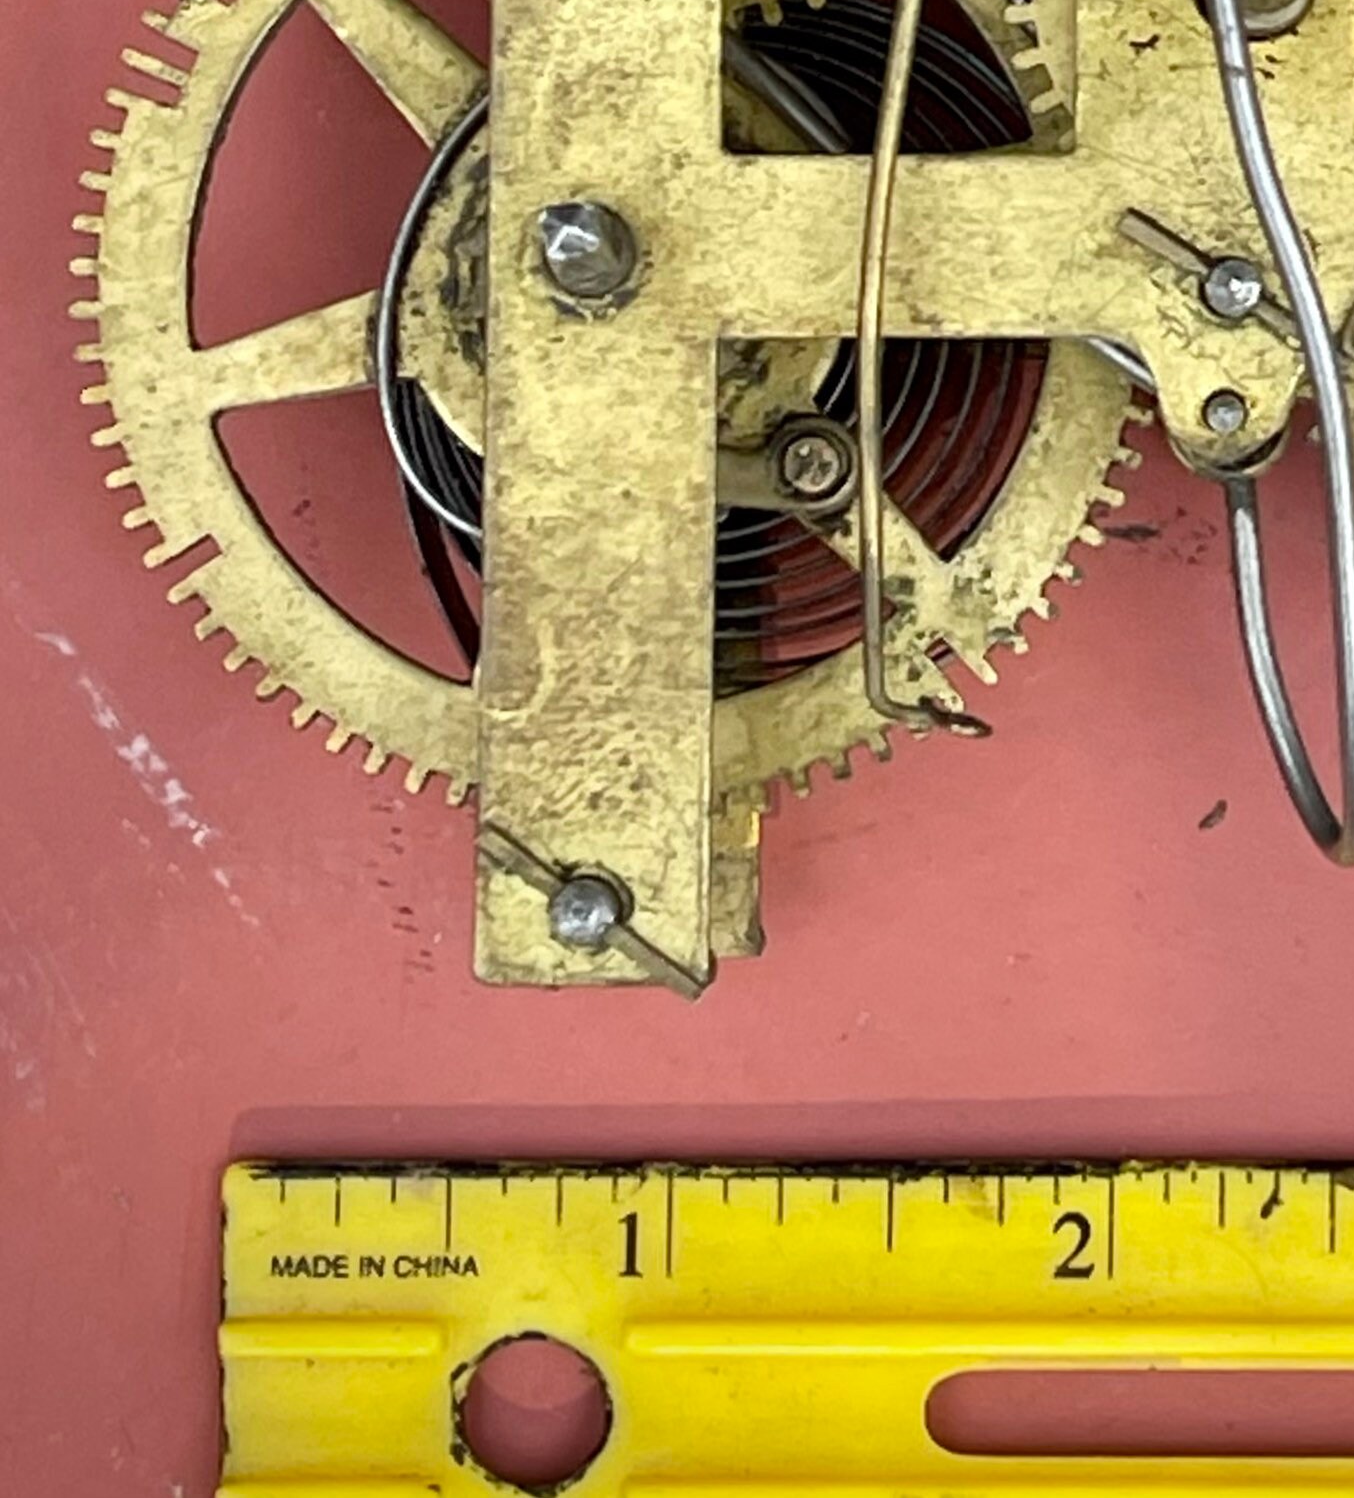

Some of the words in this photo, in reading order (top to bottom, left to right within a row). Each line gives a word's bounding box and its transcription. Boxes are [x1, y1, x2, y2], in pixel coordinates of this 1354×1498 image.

[271, 1254, 349, 1278] MADE
[358, 1254, 384, 1278] IN
[393, 1254, 479, 1278] CHINA
[617, 1211, 643, 1278] 1
[1052, 1211, 1095, 1280] 2
